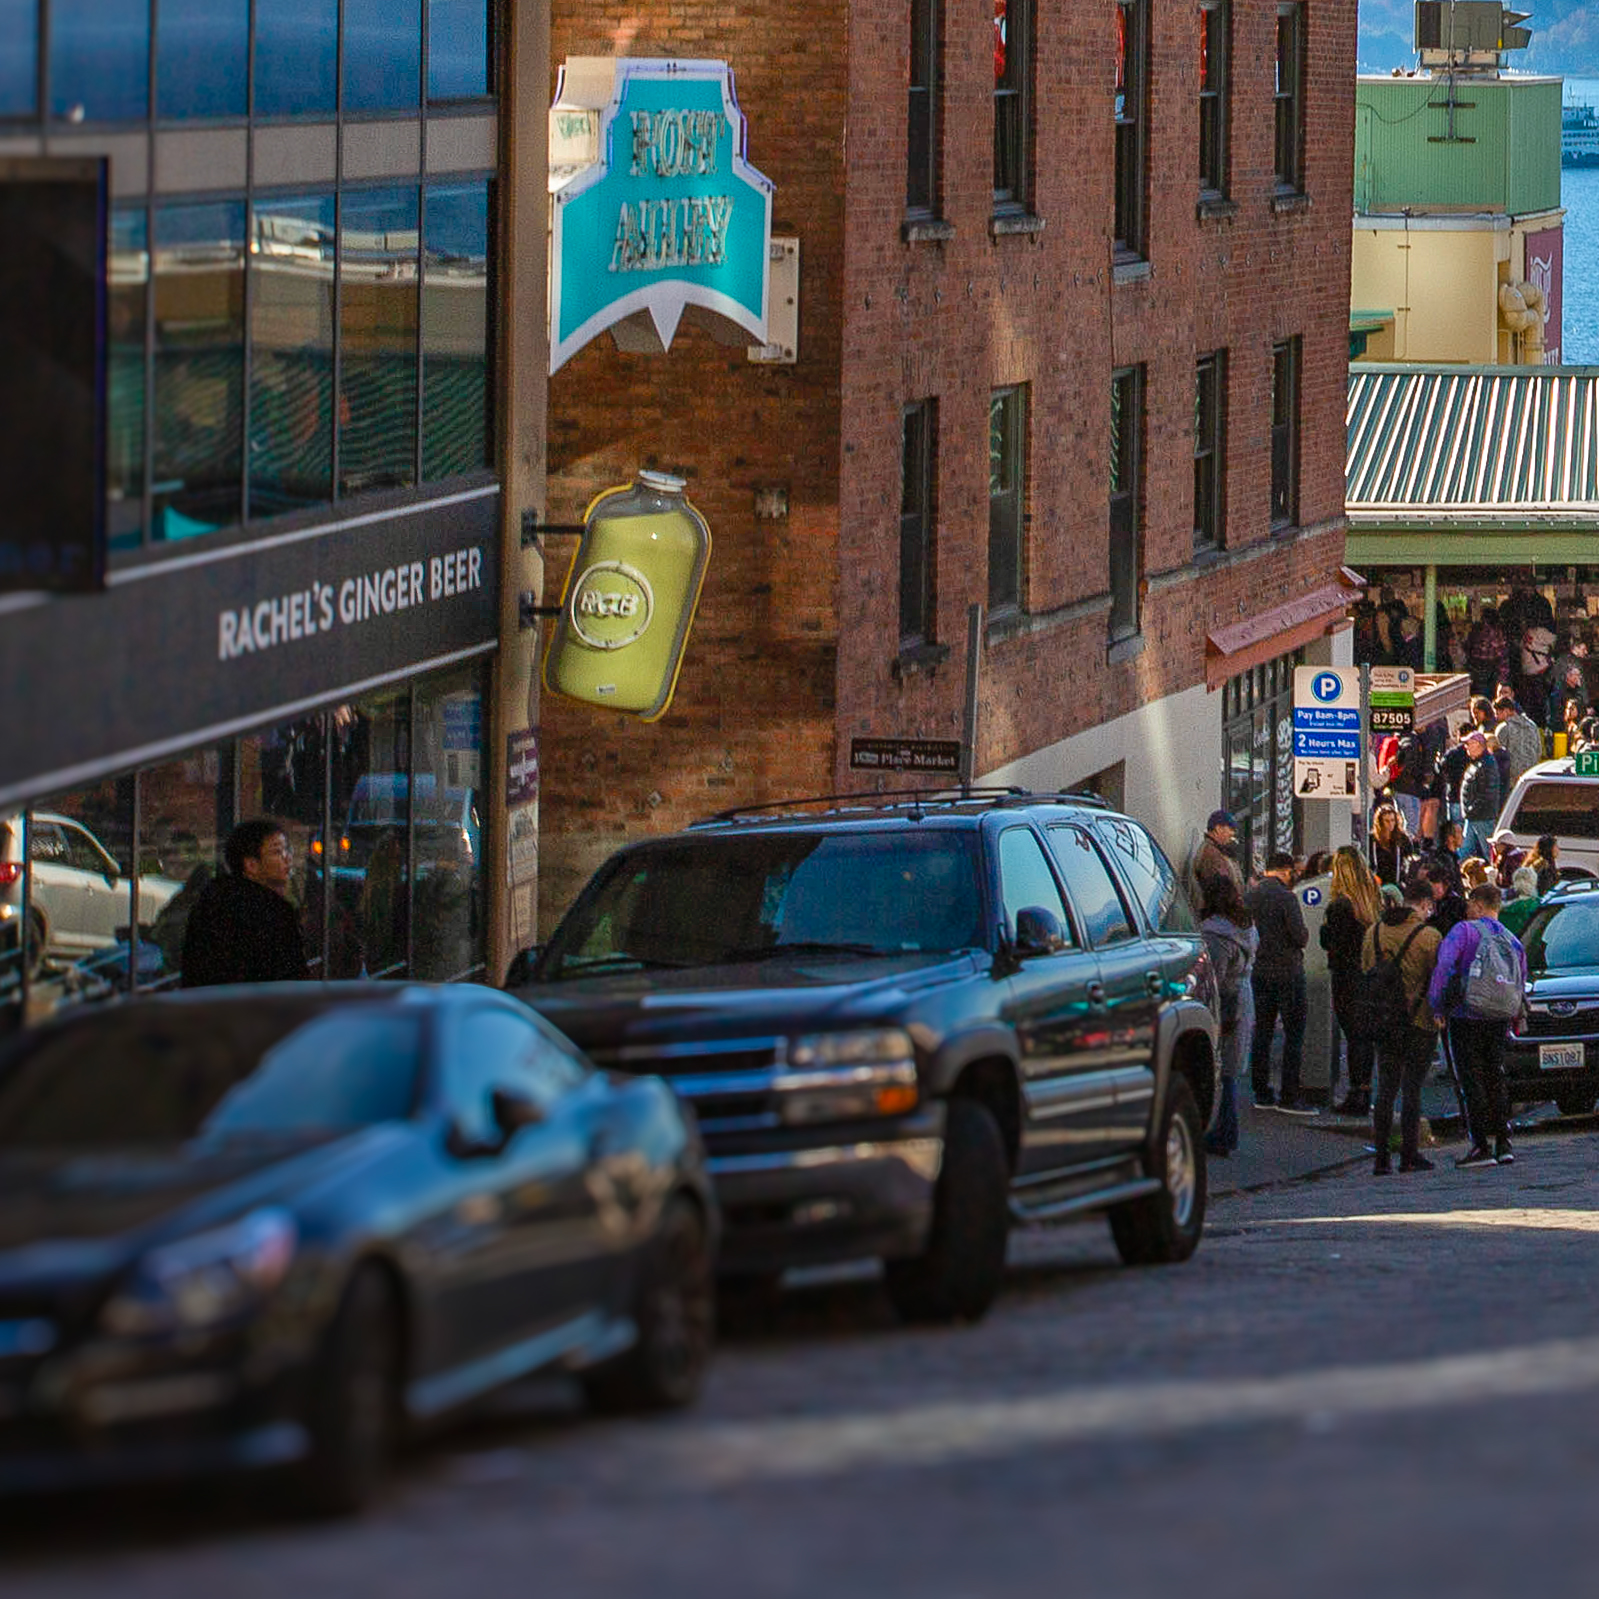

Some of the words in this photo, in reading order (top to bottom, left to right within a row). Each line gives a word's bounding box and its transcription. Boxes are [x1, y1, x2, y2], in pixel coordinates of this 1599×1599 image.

[629, 108, 726, 177] POST
[608, 195, 735, 273] ALLEY
[218, 579, 335, 662] RACHEL'S
[339, 559, 424, 625] GINGER
[430, 546, 482, 601] BEER
[1297, 710, 1313, 721] Pay
[1373, 712, 1411, 725] 87505
[1298, 733, 1307, 748] 2
[1308, 738, 1336, 748] Hours
[1337, 739, 1356, 748] Max
